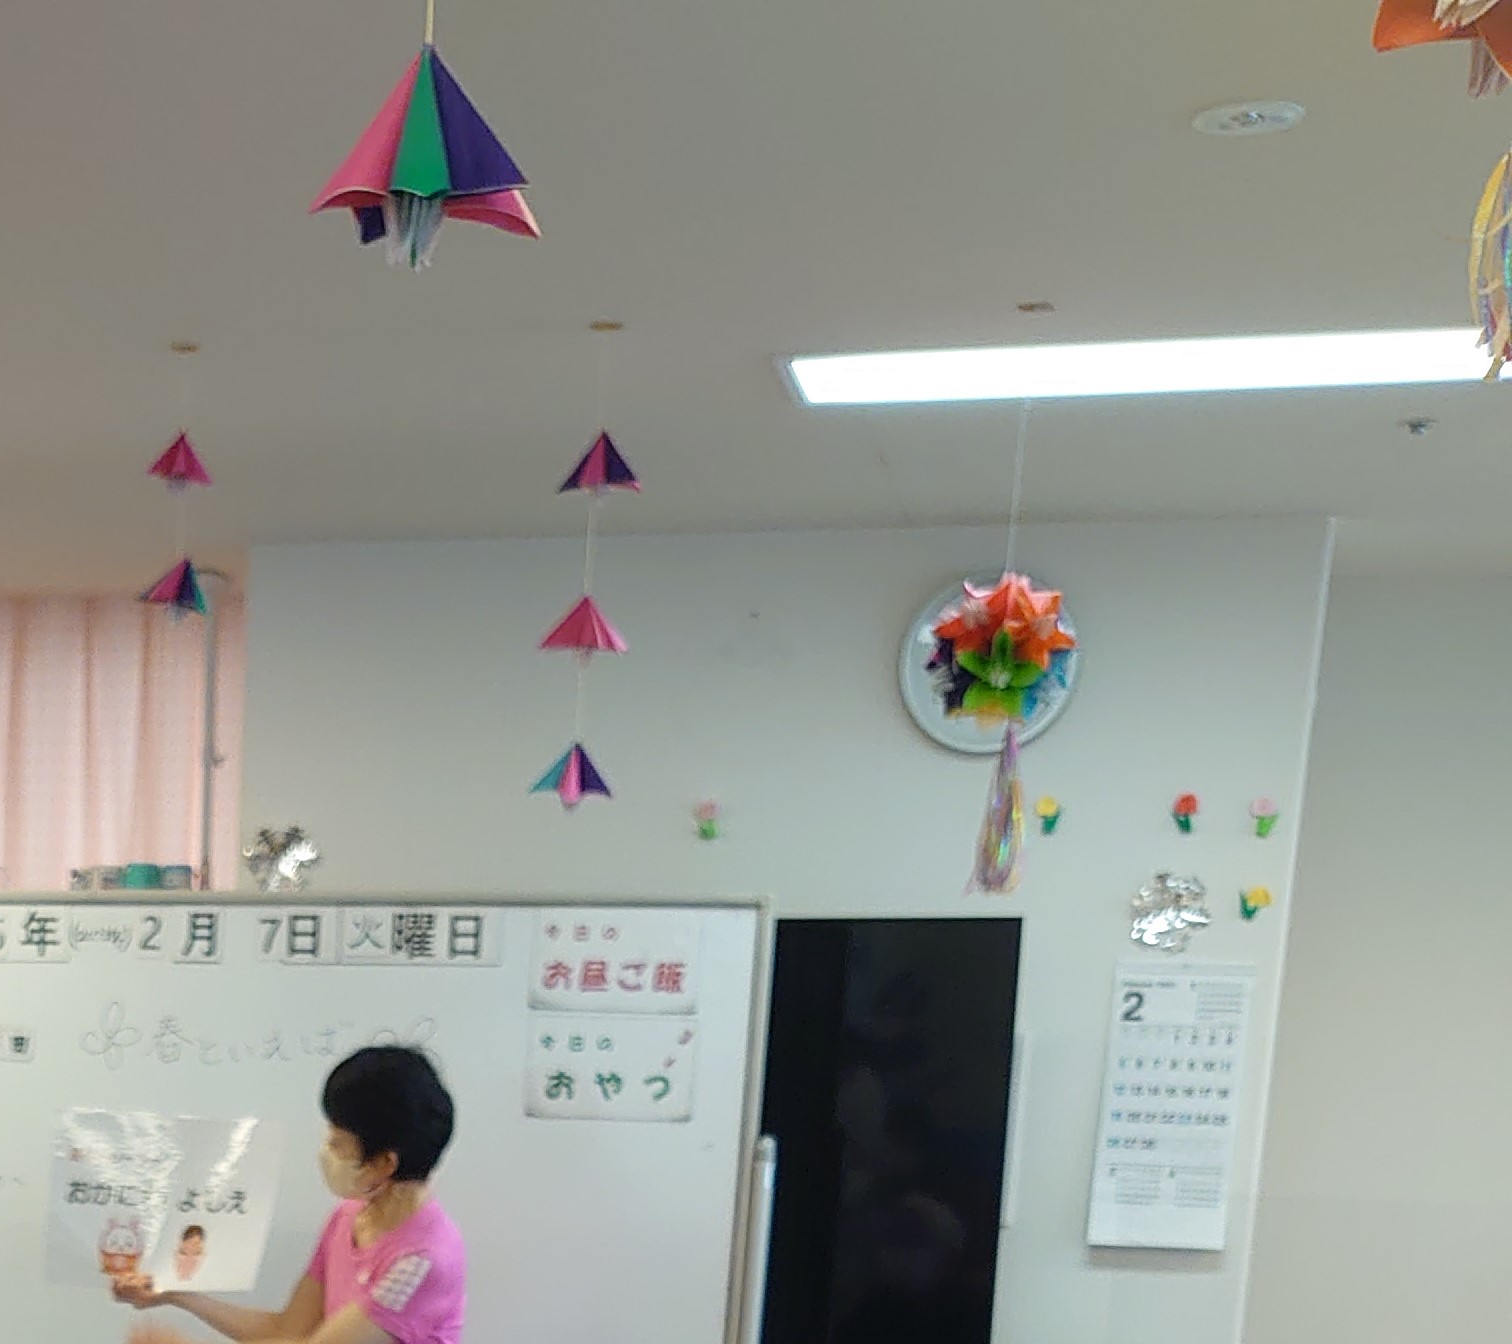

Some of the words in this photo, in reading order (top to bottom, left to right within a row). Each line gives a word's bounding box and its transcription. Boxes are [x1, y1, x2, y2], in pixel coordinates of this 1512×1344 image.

[542, 960, 688, 993] お昼ご飯
[1121, 990, 1144, 1021] 2
[544, 1071, 671, 1101] おやつ
